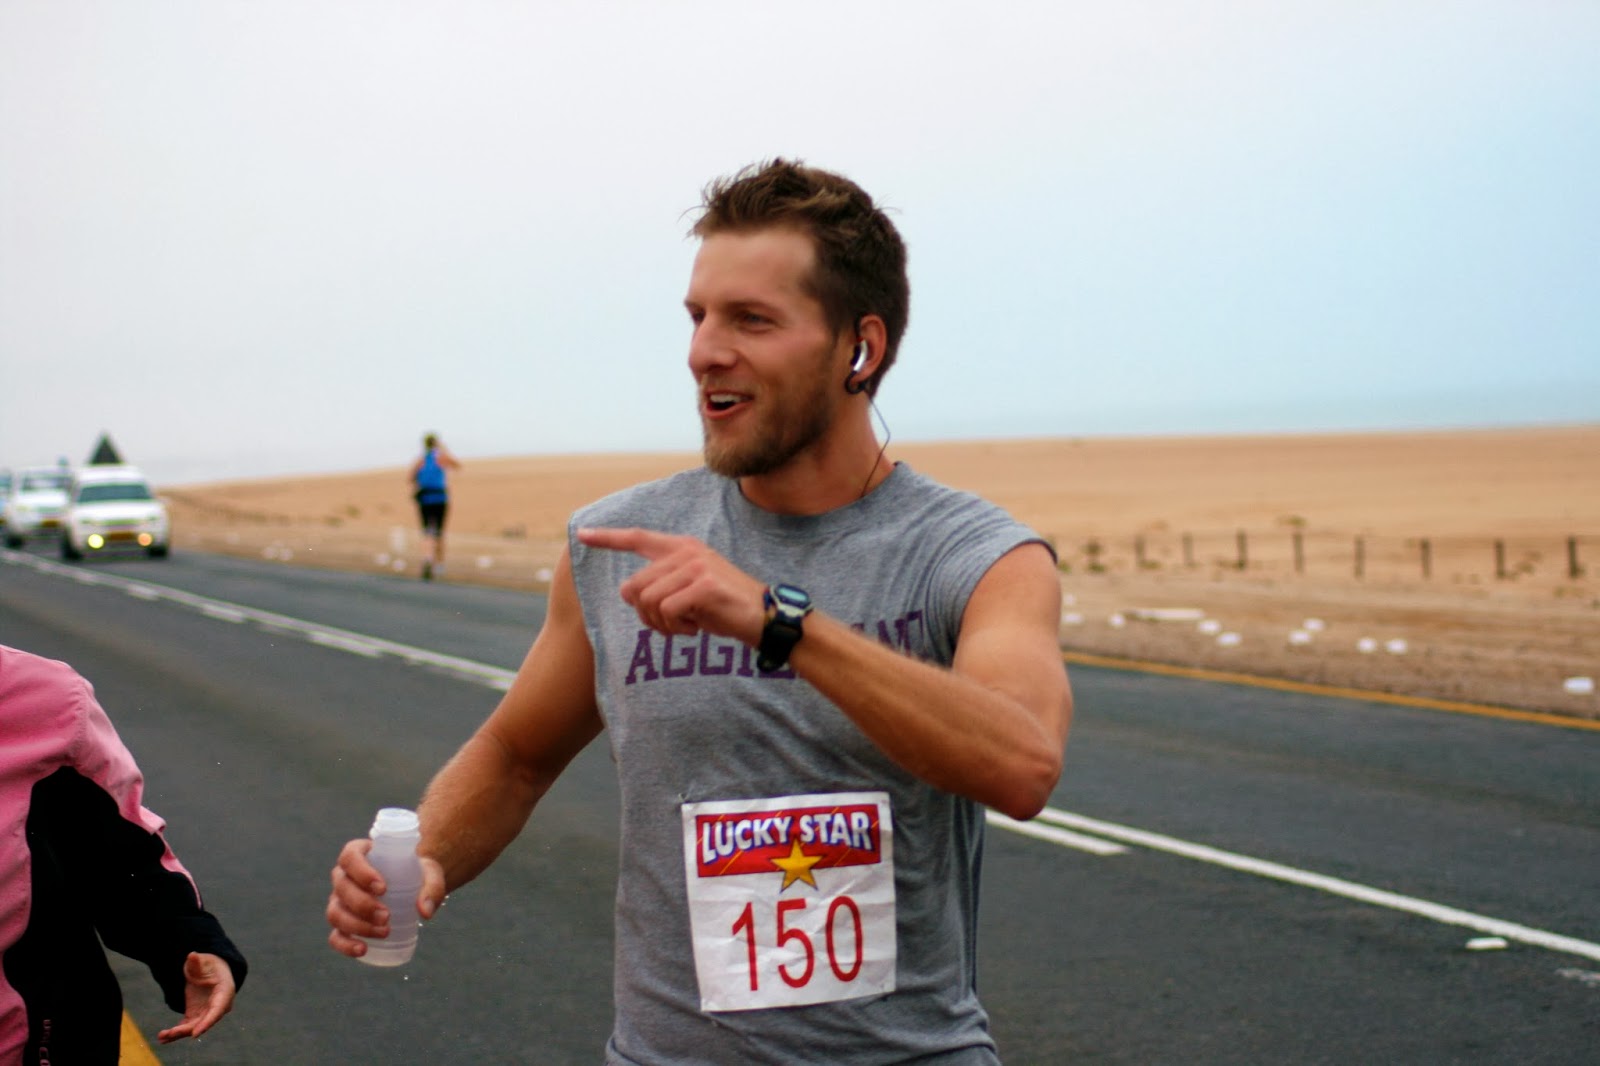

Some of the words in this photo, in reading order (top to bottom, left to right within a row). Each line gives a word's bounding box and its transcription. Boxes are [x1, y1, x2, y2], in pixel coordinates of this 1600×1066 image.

[625, 609, 924, 685] AGGIND
[702, 815, 793, 865] LUCKY
[799, 810, 874, 851] STAR
[731, 895, 864, 992] 150
